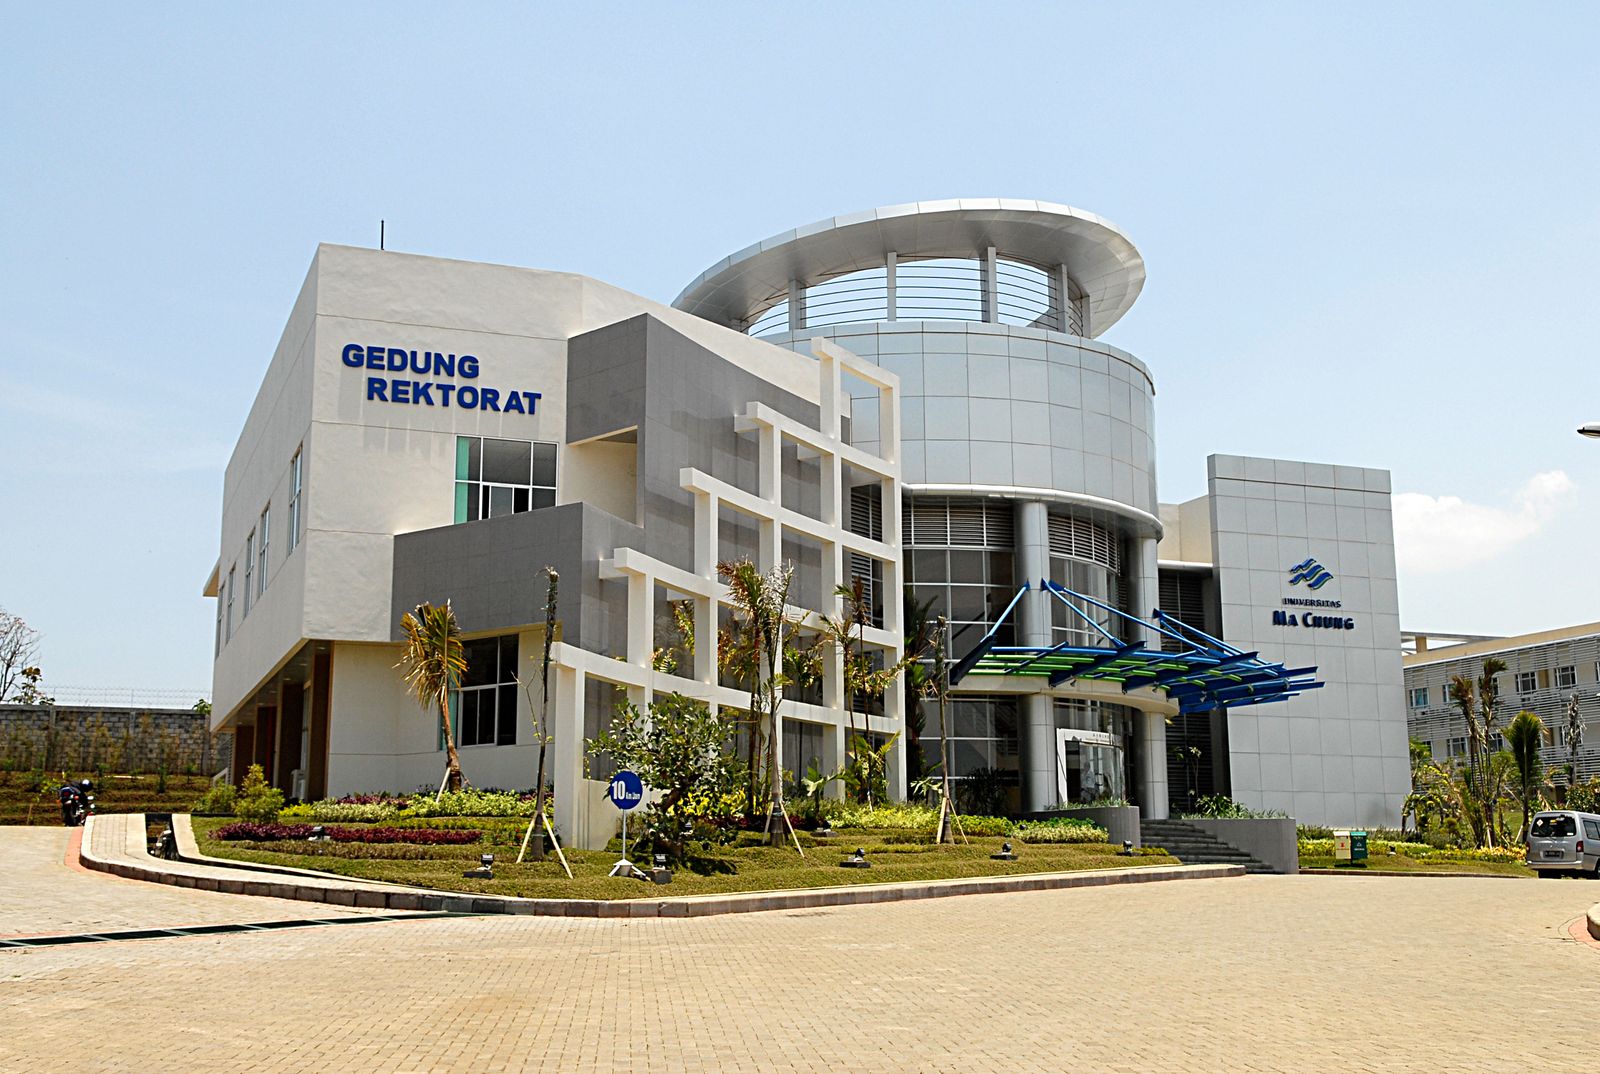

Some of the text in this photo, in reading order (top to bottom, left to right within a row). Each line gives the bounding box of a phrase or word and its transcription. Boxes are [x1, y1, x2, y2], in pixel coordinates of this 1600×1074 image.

[342, 343, 480, 379] GEDUNG
[367, 377, 542, 415] REKTORAT
[1283, 597, 1342, 608] UNIVERSITAS
[611, 780, 626, 800] 10
